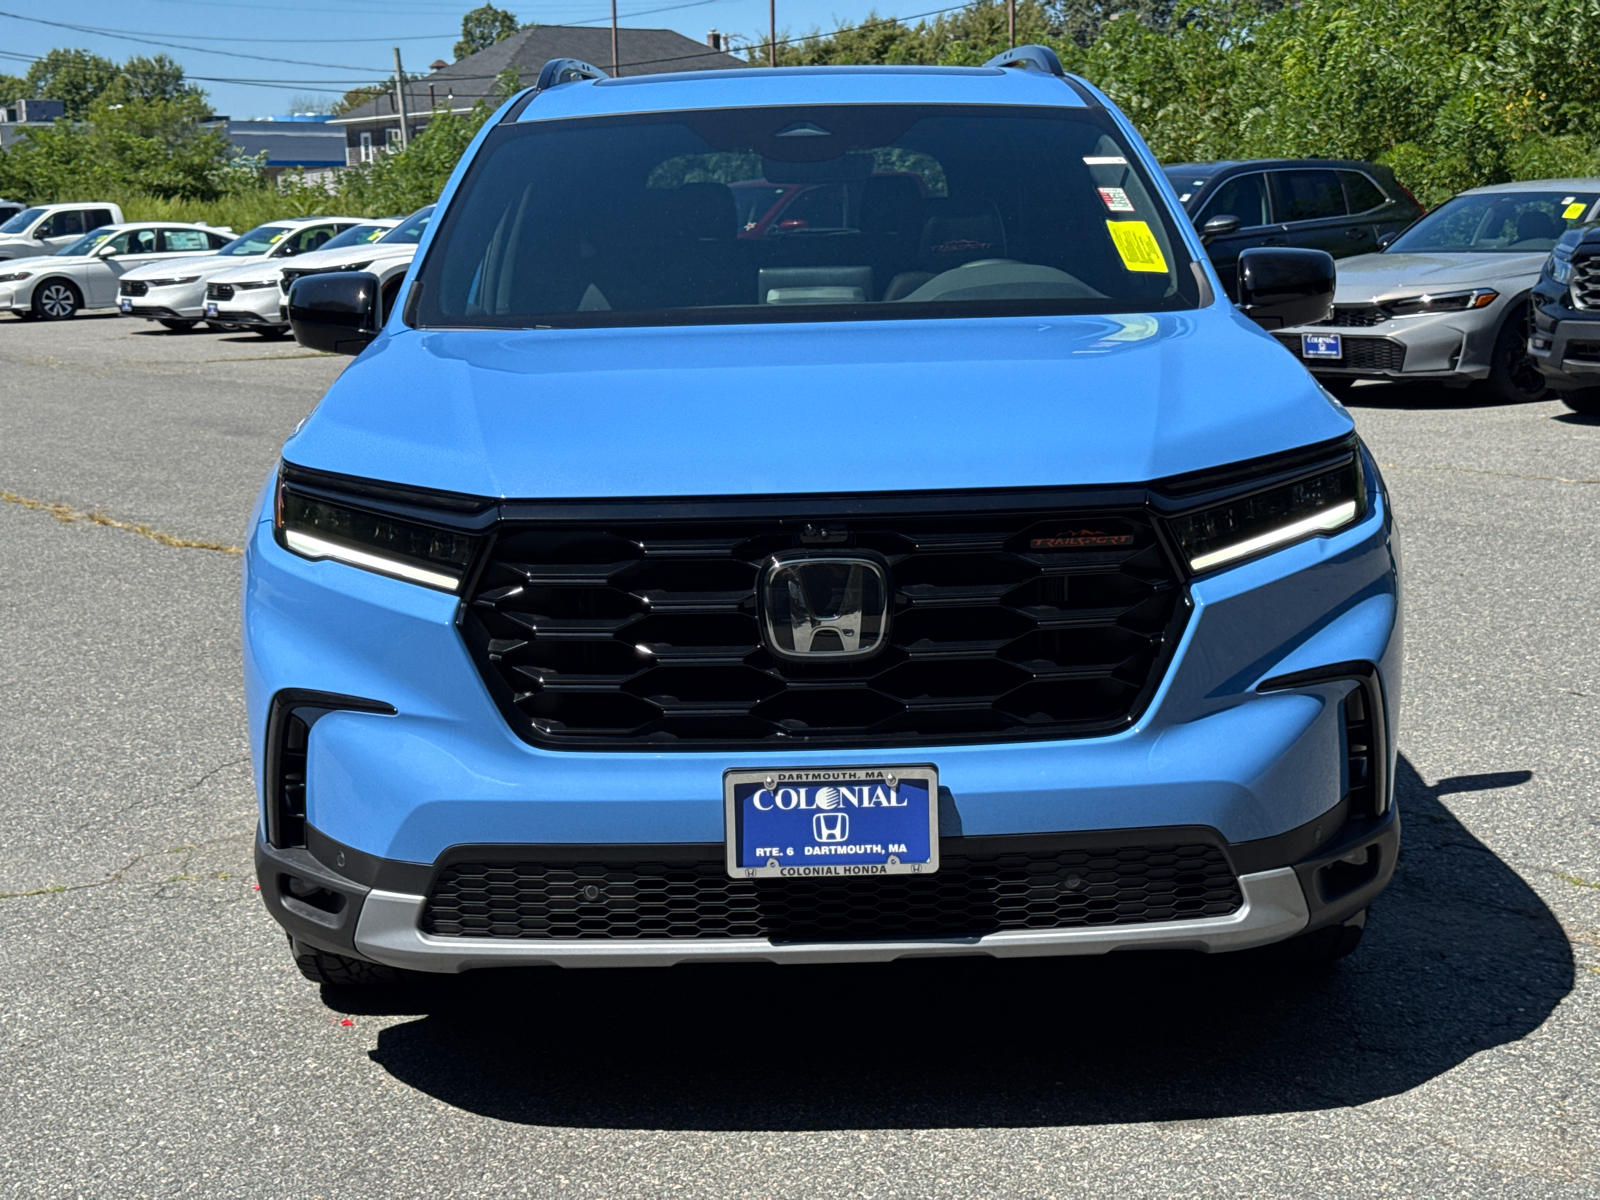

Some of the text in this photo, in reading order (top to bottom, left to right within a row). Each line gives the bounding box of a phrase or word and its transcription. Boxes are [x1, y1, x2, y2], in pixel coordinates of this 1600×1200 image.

[1033, 535, 1131, 547] TRAILSPORT
[778, 771, 884, 781] DARTMOUTH, MA
[752, 785, 908, 810] COLONIAL
[755, 843, 907, 857] RTE. 6 DARTMOUTH, MA
[780, 865, 887, 876] COLONIAL HONDA
